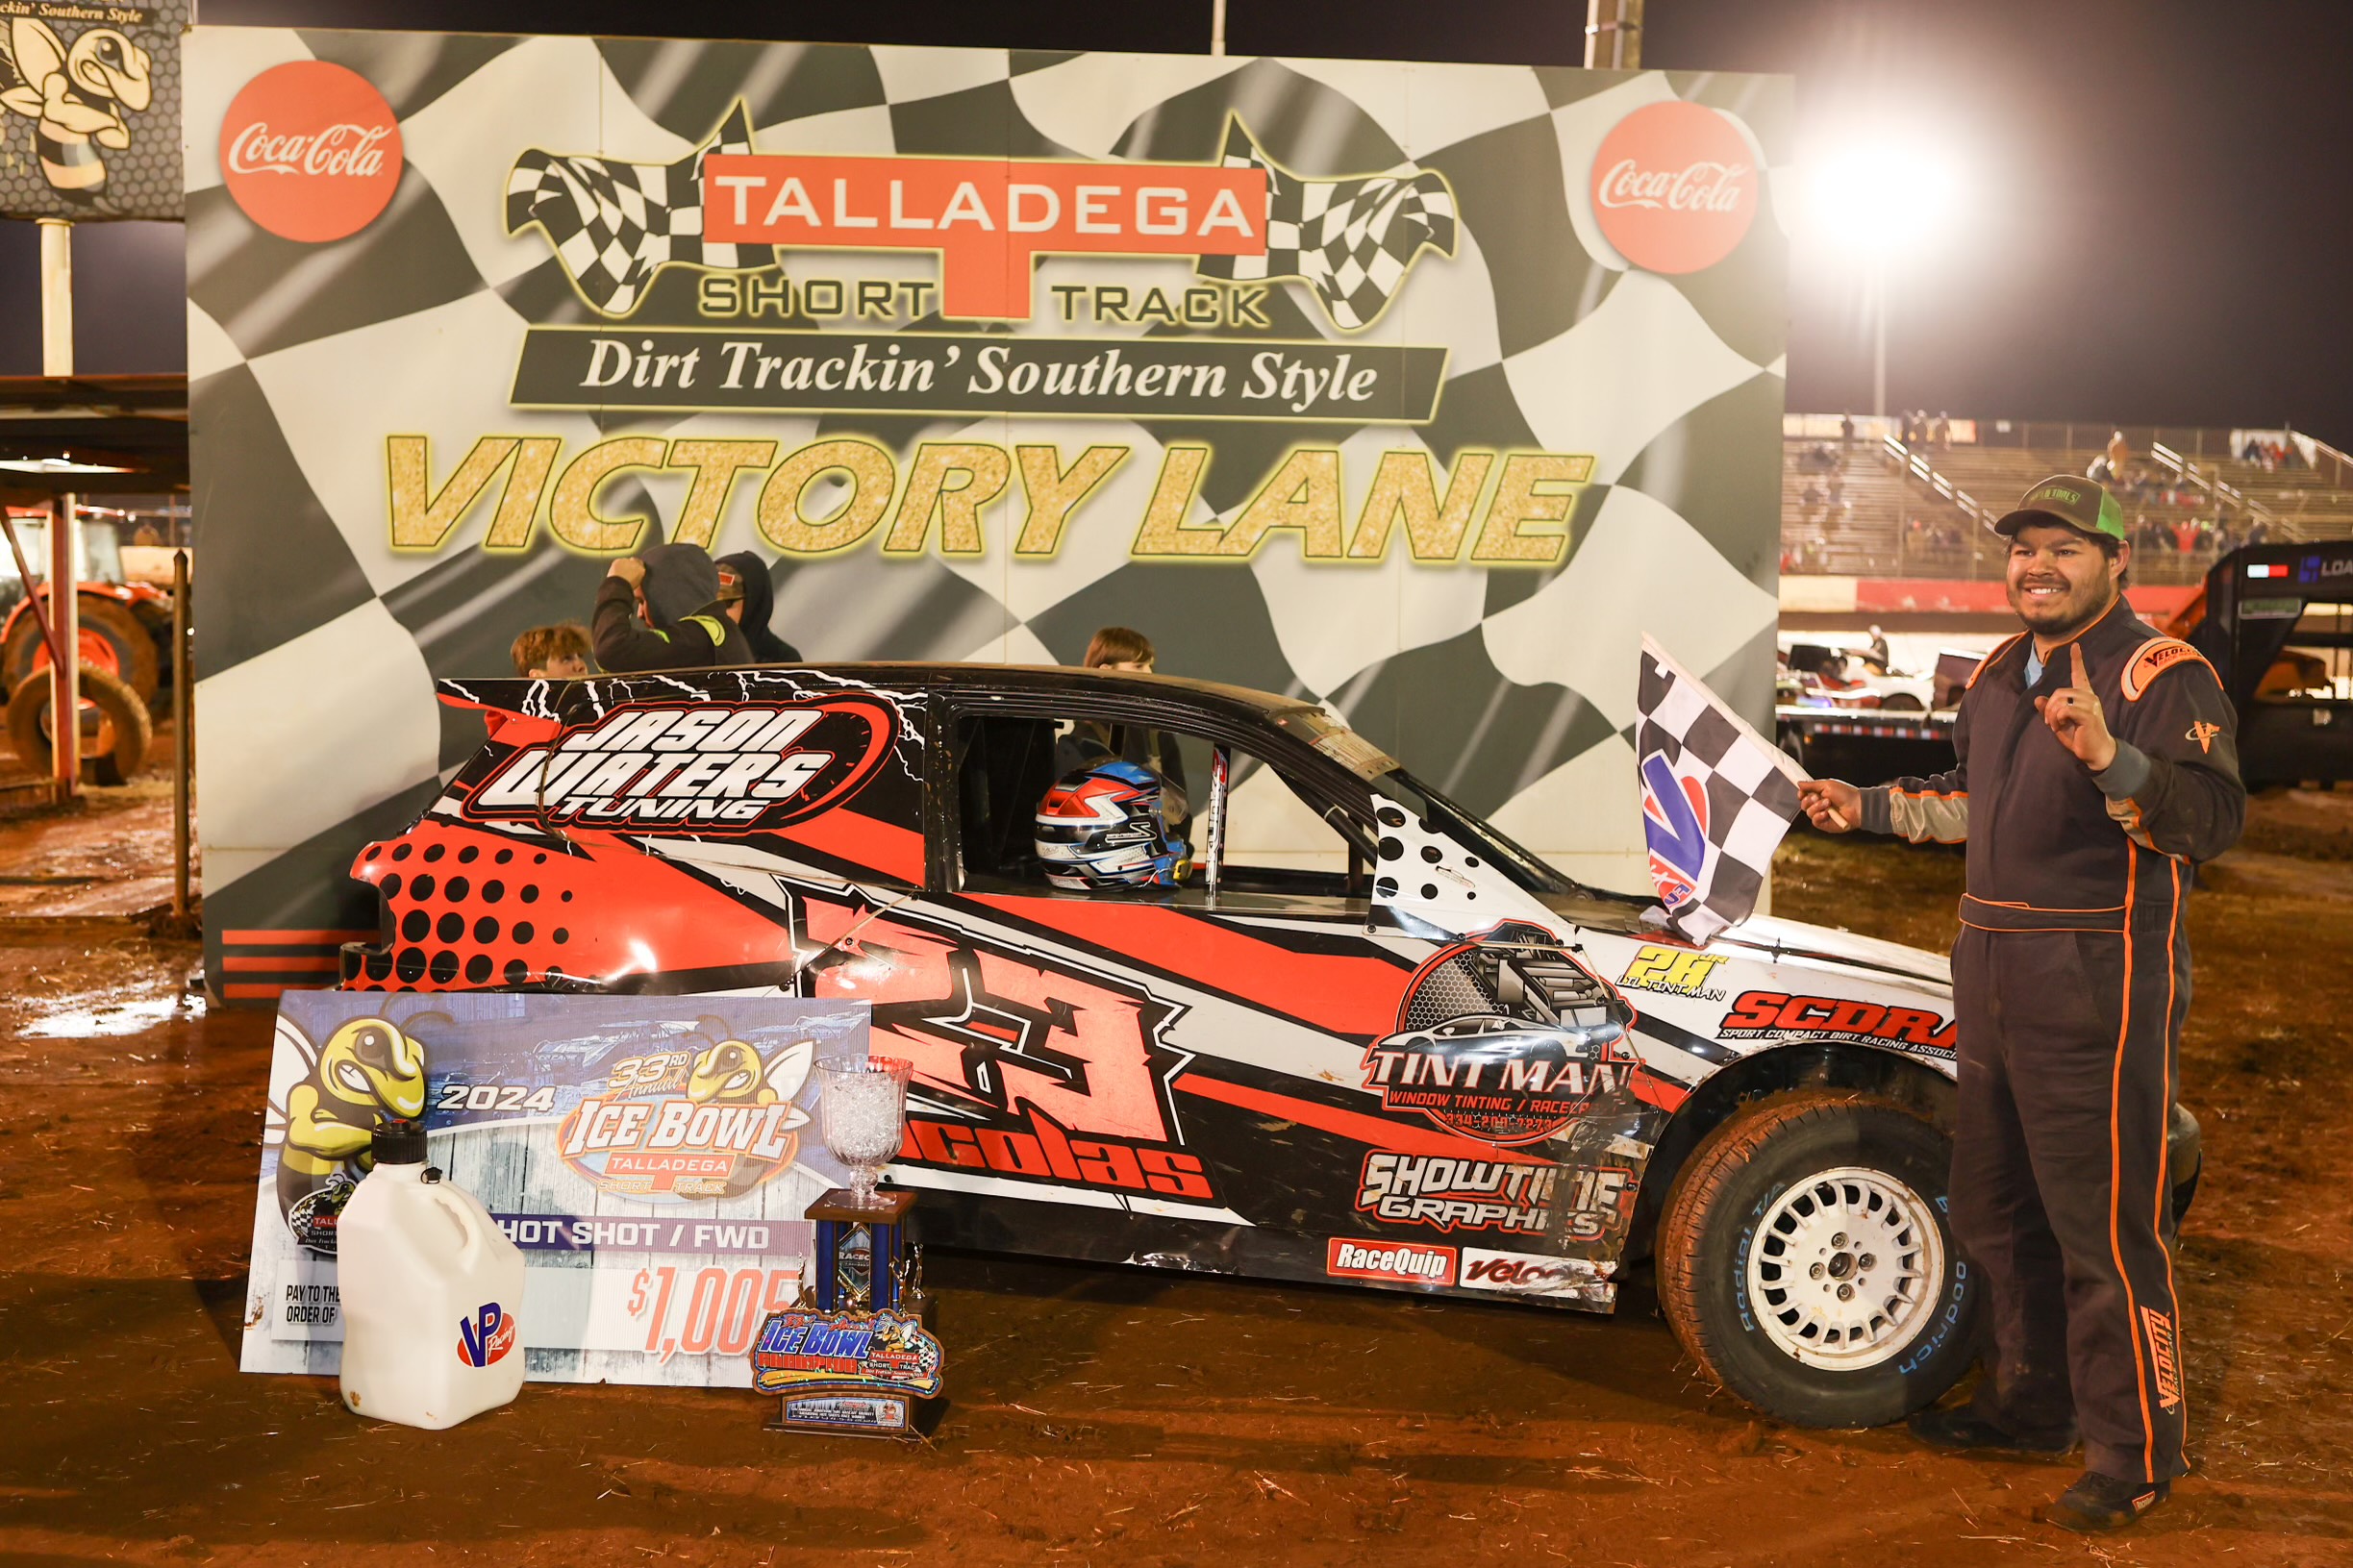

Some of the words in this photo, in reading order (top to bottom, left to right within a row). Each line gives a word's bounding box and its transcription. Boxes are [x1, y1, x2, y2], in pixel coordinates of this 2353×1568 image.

[38, 3, 104, 20] Southern
[107, 8, 143, 25] Style
[229, 122, 392, 177] Coca-Cola
[1599, 159, 1750, 212] Coca-Cola
[714, 175, 1255, 238] TALLADEGA
[702, 278, 935, 316] SHORT
[1051, 286, 1271, 325] TRACK
[579, 338, 700, 389] Dirt
[967, 345, 1226, 399] Southern
[1241, 351, 1378, 413] Style
[386, 435, 1131, 553] VICTORY
[1130, 446, 1596, 561] LANE
[563, 709, 824, 753] JASON
[477, 749, 834, 807] WATERS
[563, 796, 771, 820] TUNING
[1615, 974, 1640, 988] LIL
[1646, 979, 1688, 994] TINT
[1686, 986, 1727, 1002] MAN
[1765, 1029, 1828, 1041] COMPACT
[1861, 1035, 1908, 1051] RACING
[1909, 1043, 1957, 1059] ASSOCI
[608, 1051, 689, 1088] 33RD
[616, 1068, 685, 1102] Annual
[1371, 1050, 1488, 1089] TINT
[1497, 1058, 1631, 1096] MAN
[436, 1083, 557, 1112] 2024
[1389, 1090, 1453, 1108] WINDOW
[1455, 1094, 1513, 1111] TINTING
[1516, 1099, 1527, 1112] /
[563, 1100, 653, 1157] ICE
[647, 1100, 788, 1161] BOWL
[611, 1157, 728, 1173] TALLADEGA
[897, 1108, 1214, 1200] colas
[599, 1180, 652, 1192] SHORT
[675, 1181, 726, 1194] TRACK
[497, 1220, 563, 1244] HOT
[572, 1222, 662, 1247] SHOT
[668, 1224, 682, 1247] /
[694, 1224, 769, 1250] FWD
[1378, 1196, 1600, 1235] GRAPHIS
[1336, 1243, 1448, 1279] RaceQuip
[1734, 1228, 1755, 1332] Radial
[286, 1284, 306, 1302] PAY
[308, 1284, 320, 1303] TO
[286, 1306, 320, 1323] ORDER
[322, 1306, 336, 1324] OF
[1898, 1260, 1967, 1377] oodrich
[460, 1302, 502, 1368] VP
[758, 1319, 809, 1355] ICE
[799, 1322, 874, 1359] BOWL
[871, 1352, 918, 1361] TALLADEGA
[2140, 1305, 2182, 1408] VELOCITY
